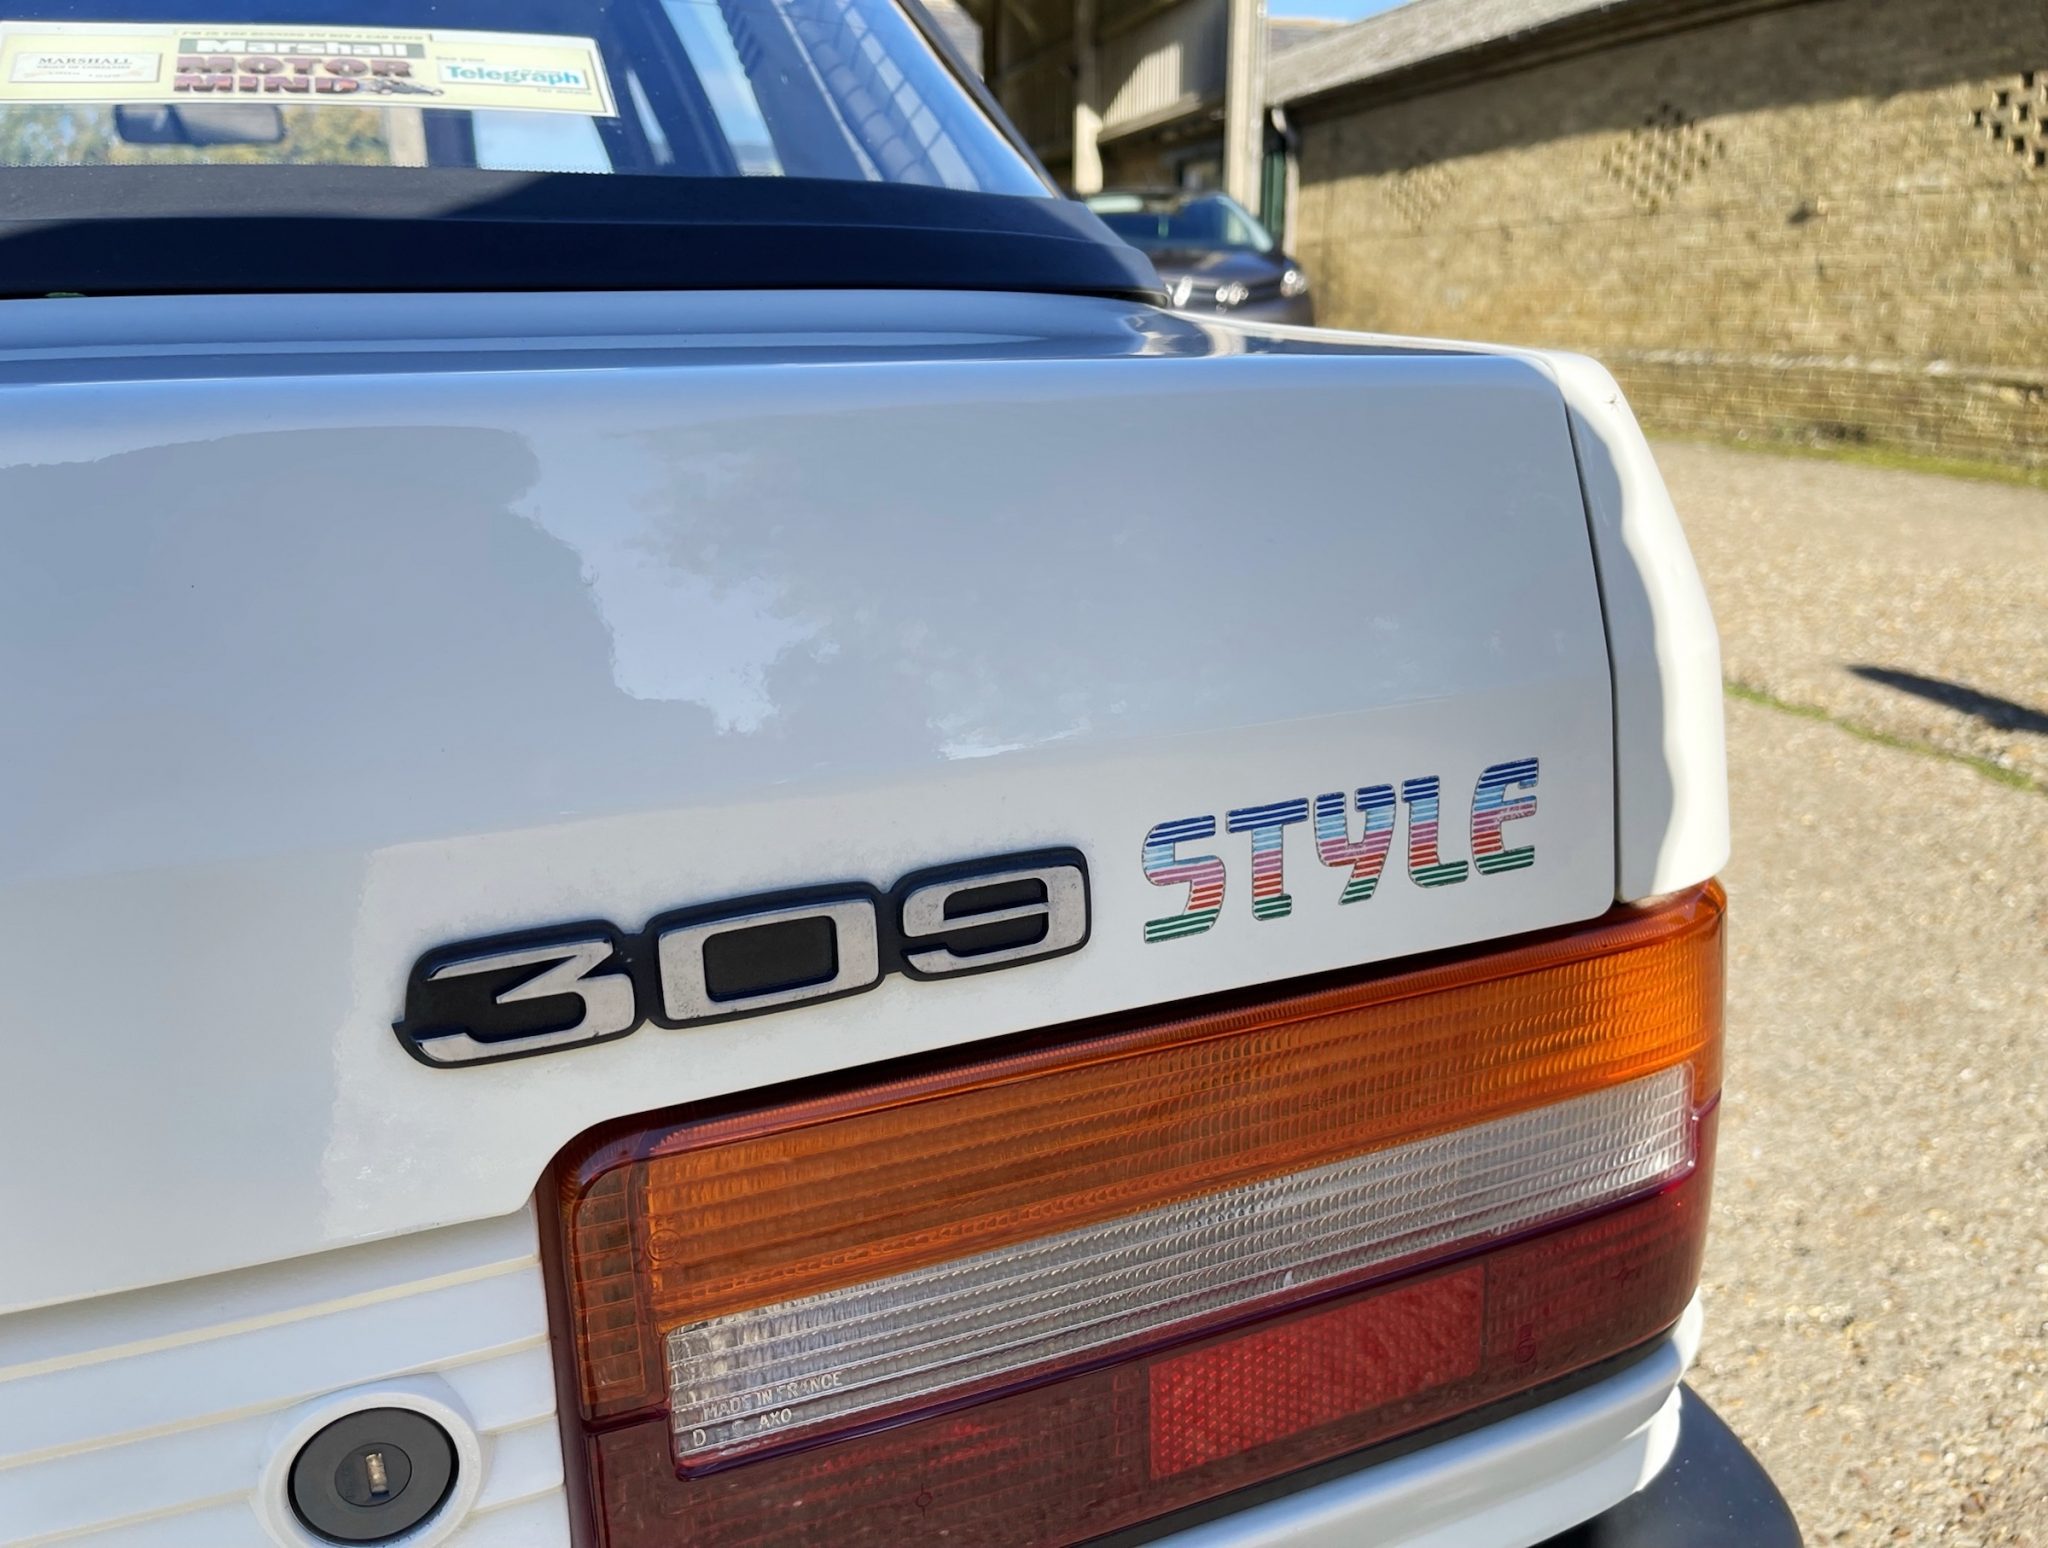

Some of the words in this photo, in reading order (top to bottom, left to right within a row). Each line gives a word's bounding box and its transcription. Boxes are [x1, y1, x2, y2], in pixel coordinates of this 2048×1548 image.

[197, 40, 408, 56] Marshall
[38, 57, 133, 65] MARSHALL
[177, 56, 413, 77] MOTOR
[173, 75, 360, 93] MIND
[445, 65, 581, 86] Telegraph
[1143, 757, 1540, 943] STYLE
[412, 850, 1089, 1064] 309
[703, 1397, 752, 1420] MADE
[756, 1391, 773, 1405] IN
[777, 1371, 843, 1400] FRANCE
[758, 1407, 793, 1429] AXO
